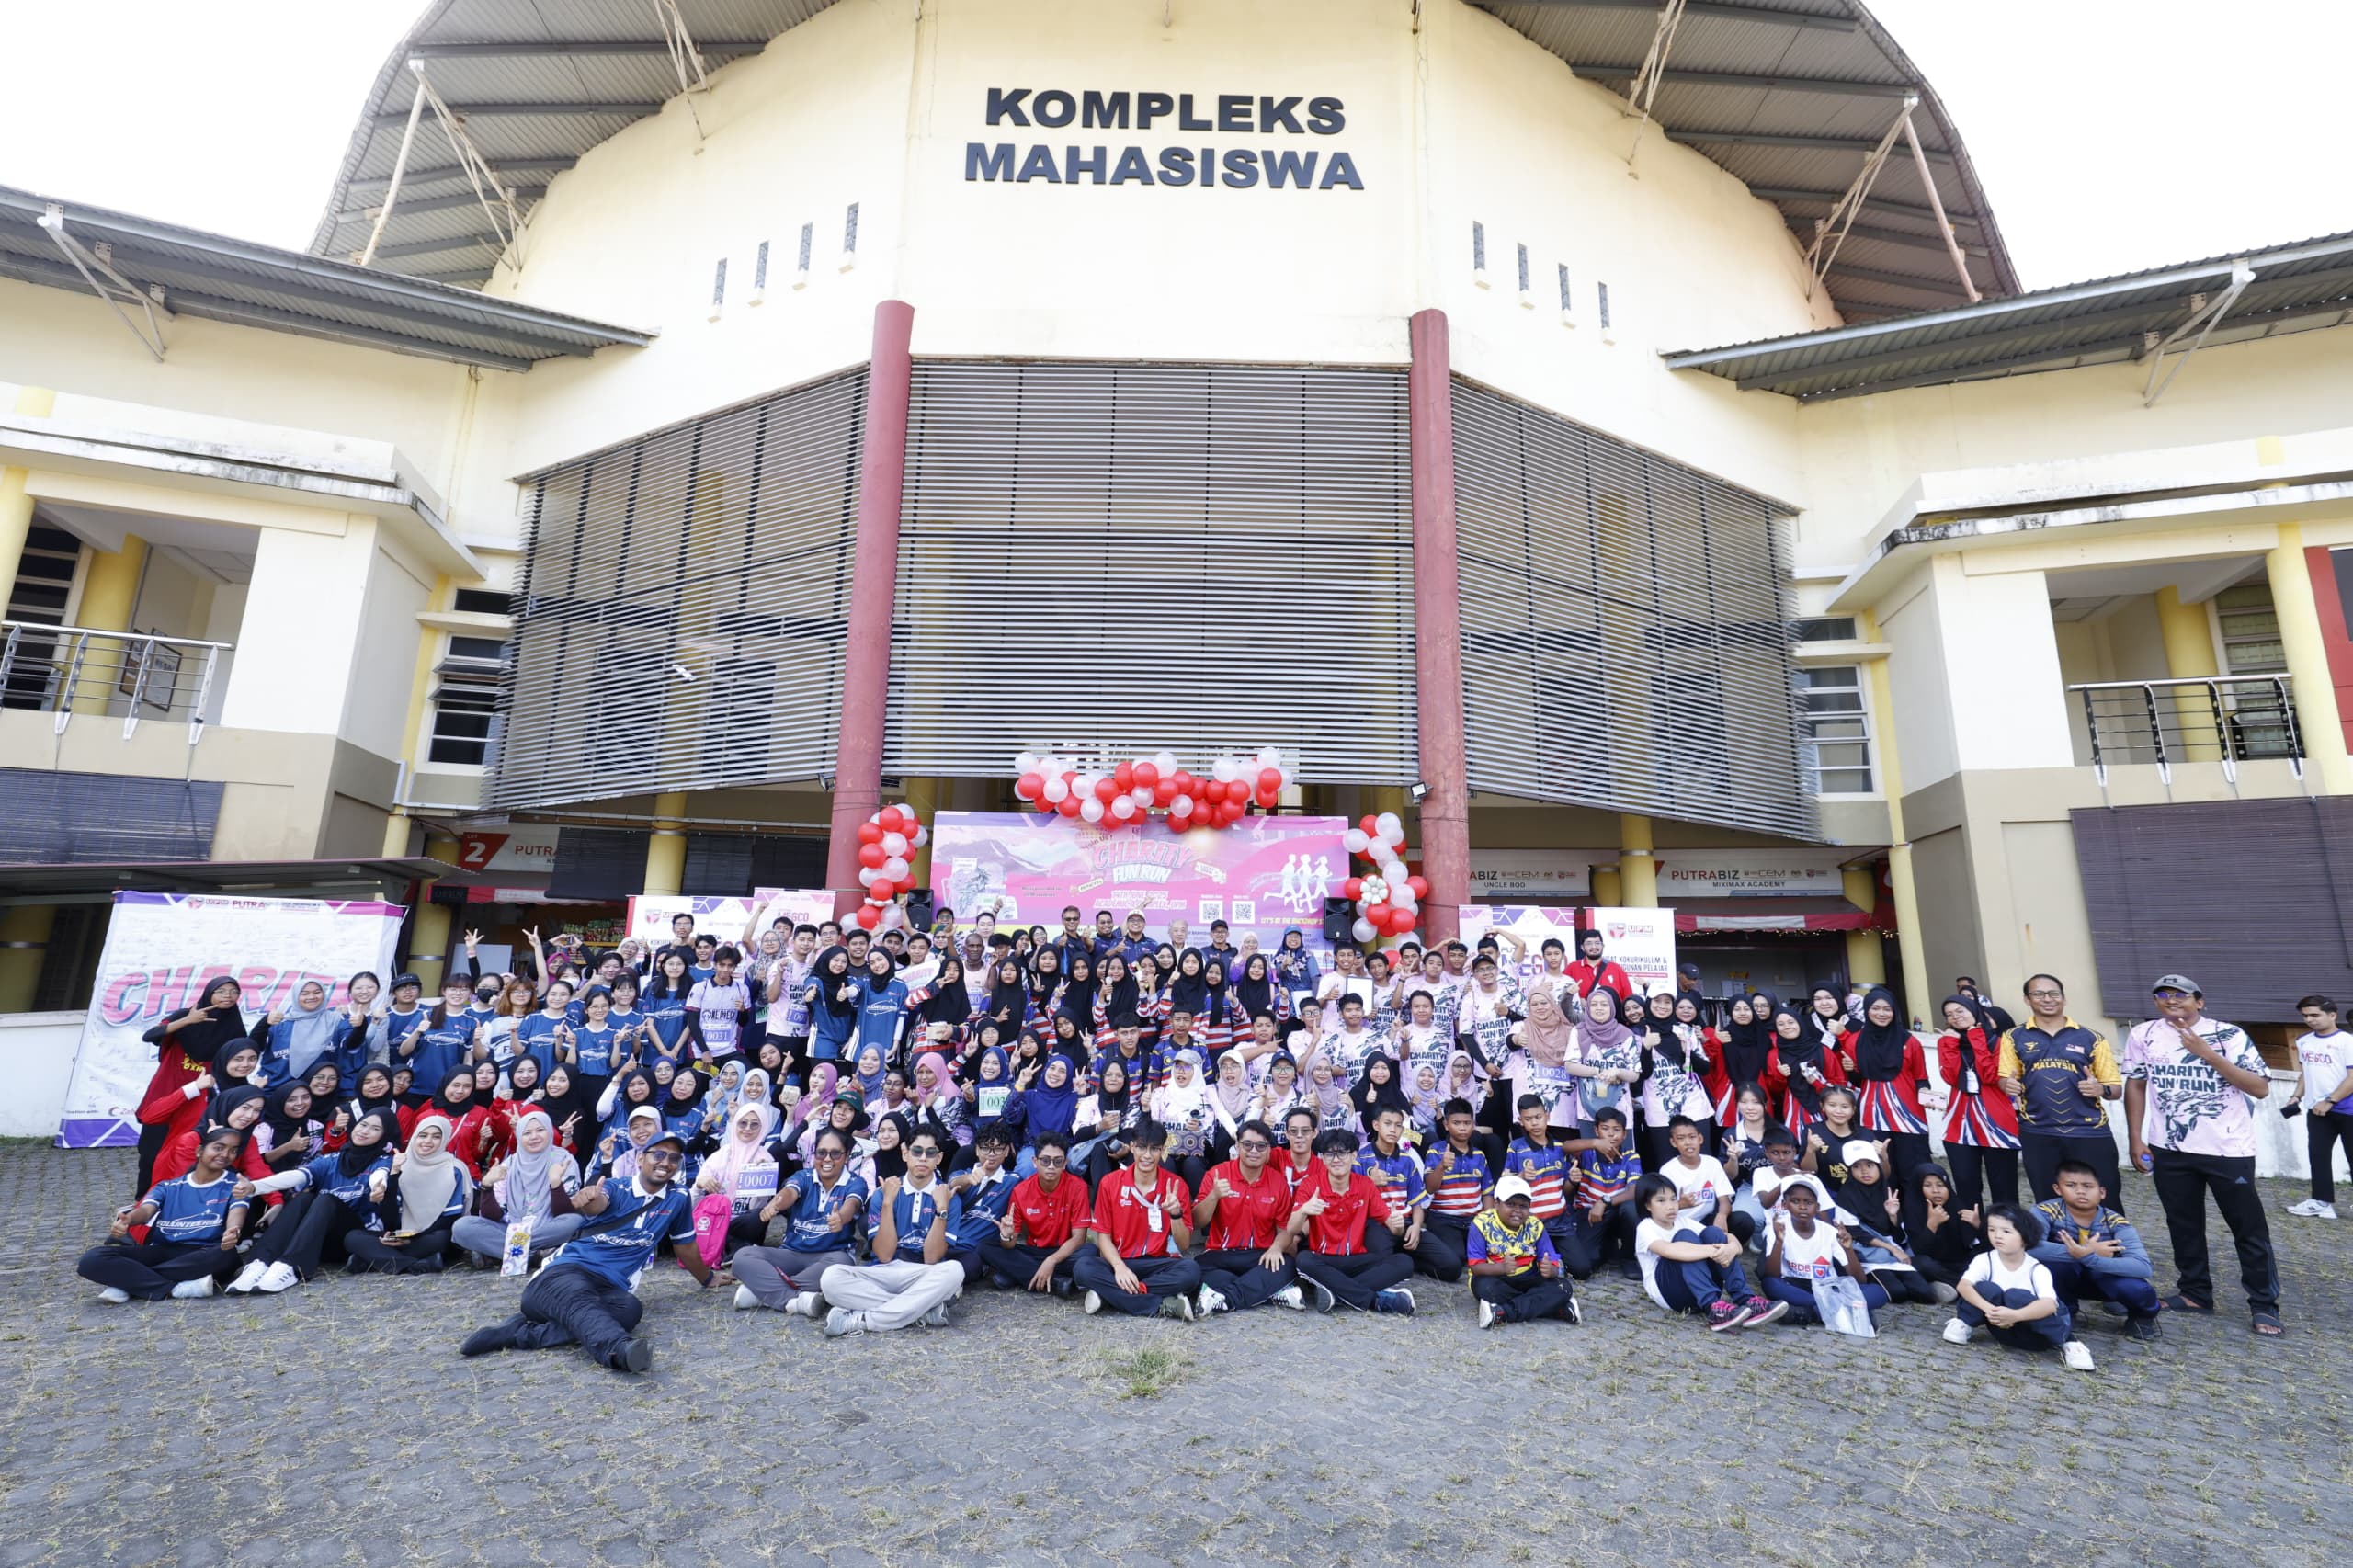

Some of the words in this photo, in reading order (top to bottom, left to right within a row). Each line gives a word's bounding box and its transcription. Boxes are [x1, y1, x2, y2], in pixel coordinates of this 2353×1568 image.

[985, 87, 1346, 136] KOMPLEKS
[964, 142, 1366, 191] MAHASISWA
[464, 841, 487, 863] 2
[1093, 839, 1193, 869] CHARITY
[1113, 864, 1142, 884] FUN
[1144, 865, 1172, 884] RUN
[1470, 870, 1497, 881] ABIZ
[1671, 870, 1740, 881] PUTRABIZ
[1619, 955, 1661, 963] KOKURIKULUM
[1477, 1018, 1509, 1030] CHARIT
[1409, 1051, 1446, 1061] CHARITY
[1542, 1067, 1568, 1079] 0028
[2032, 1061, 2079, 1074] MALAYSIA
[2179, 1079, 2217, 1093] RUN
[745, 1174, 775, 1187] 0007
